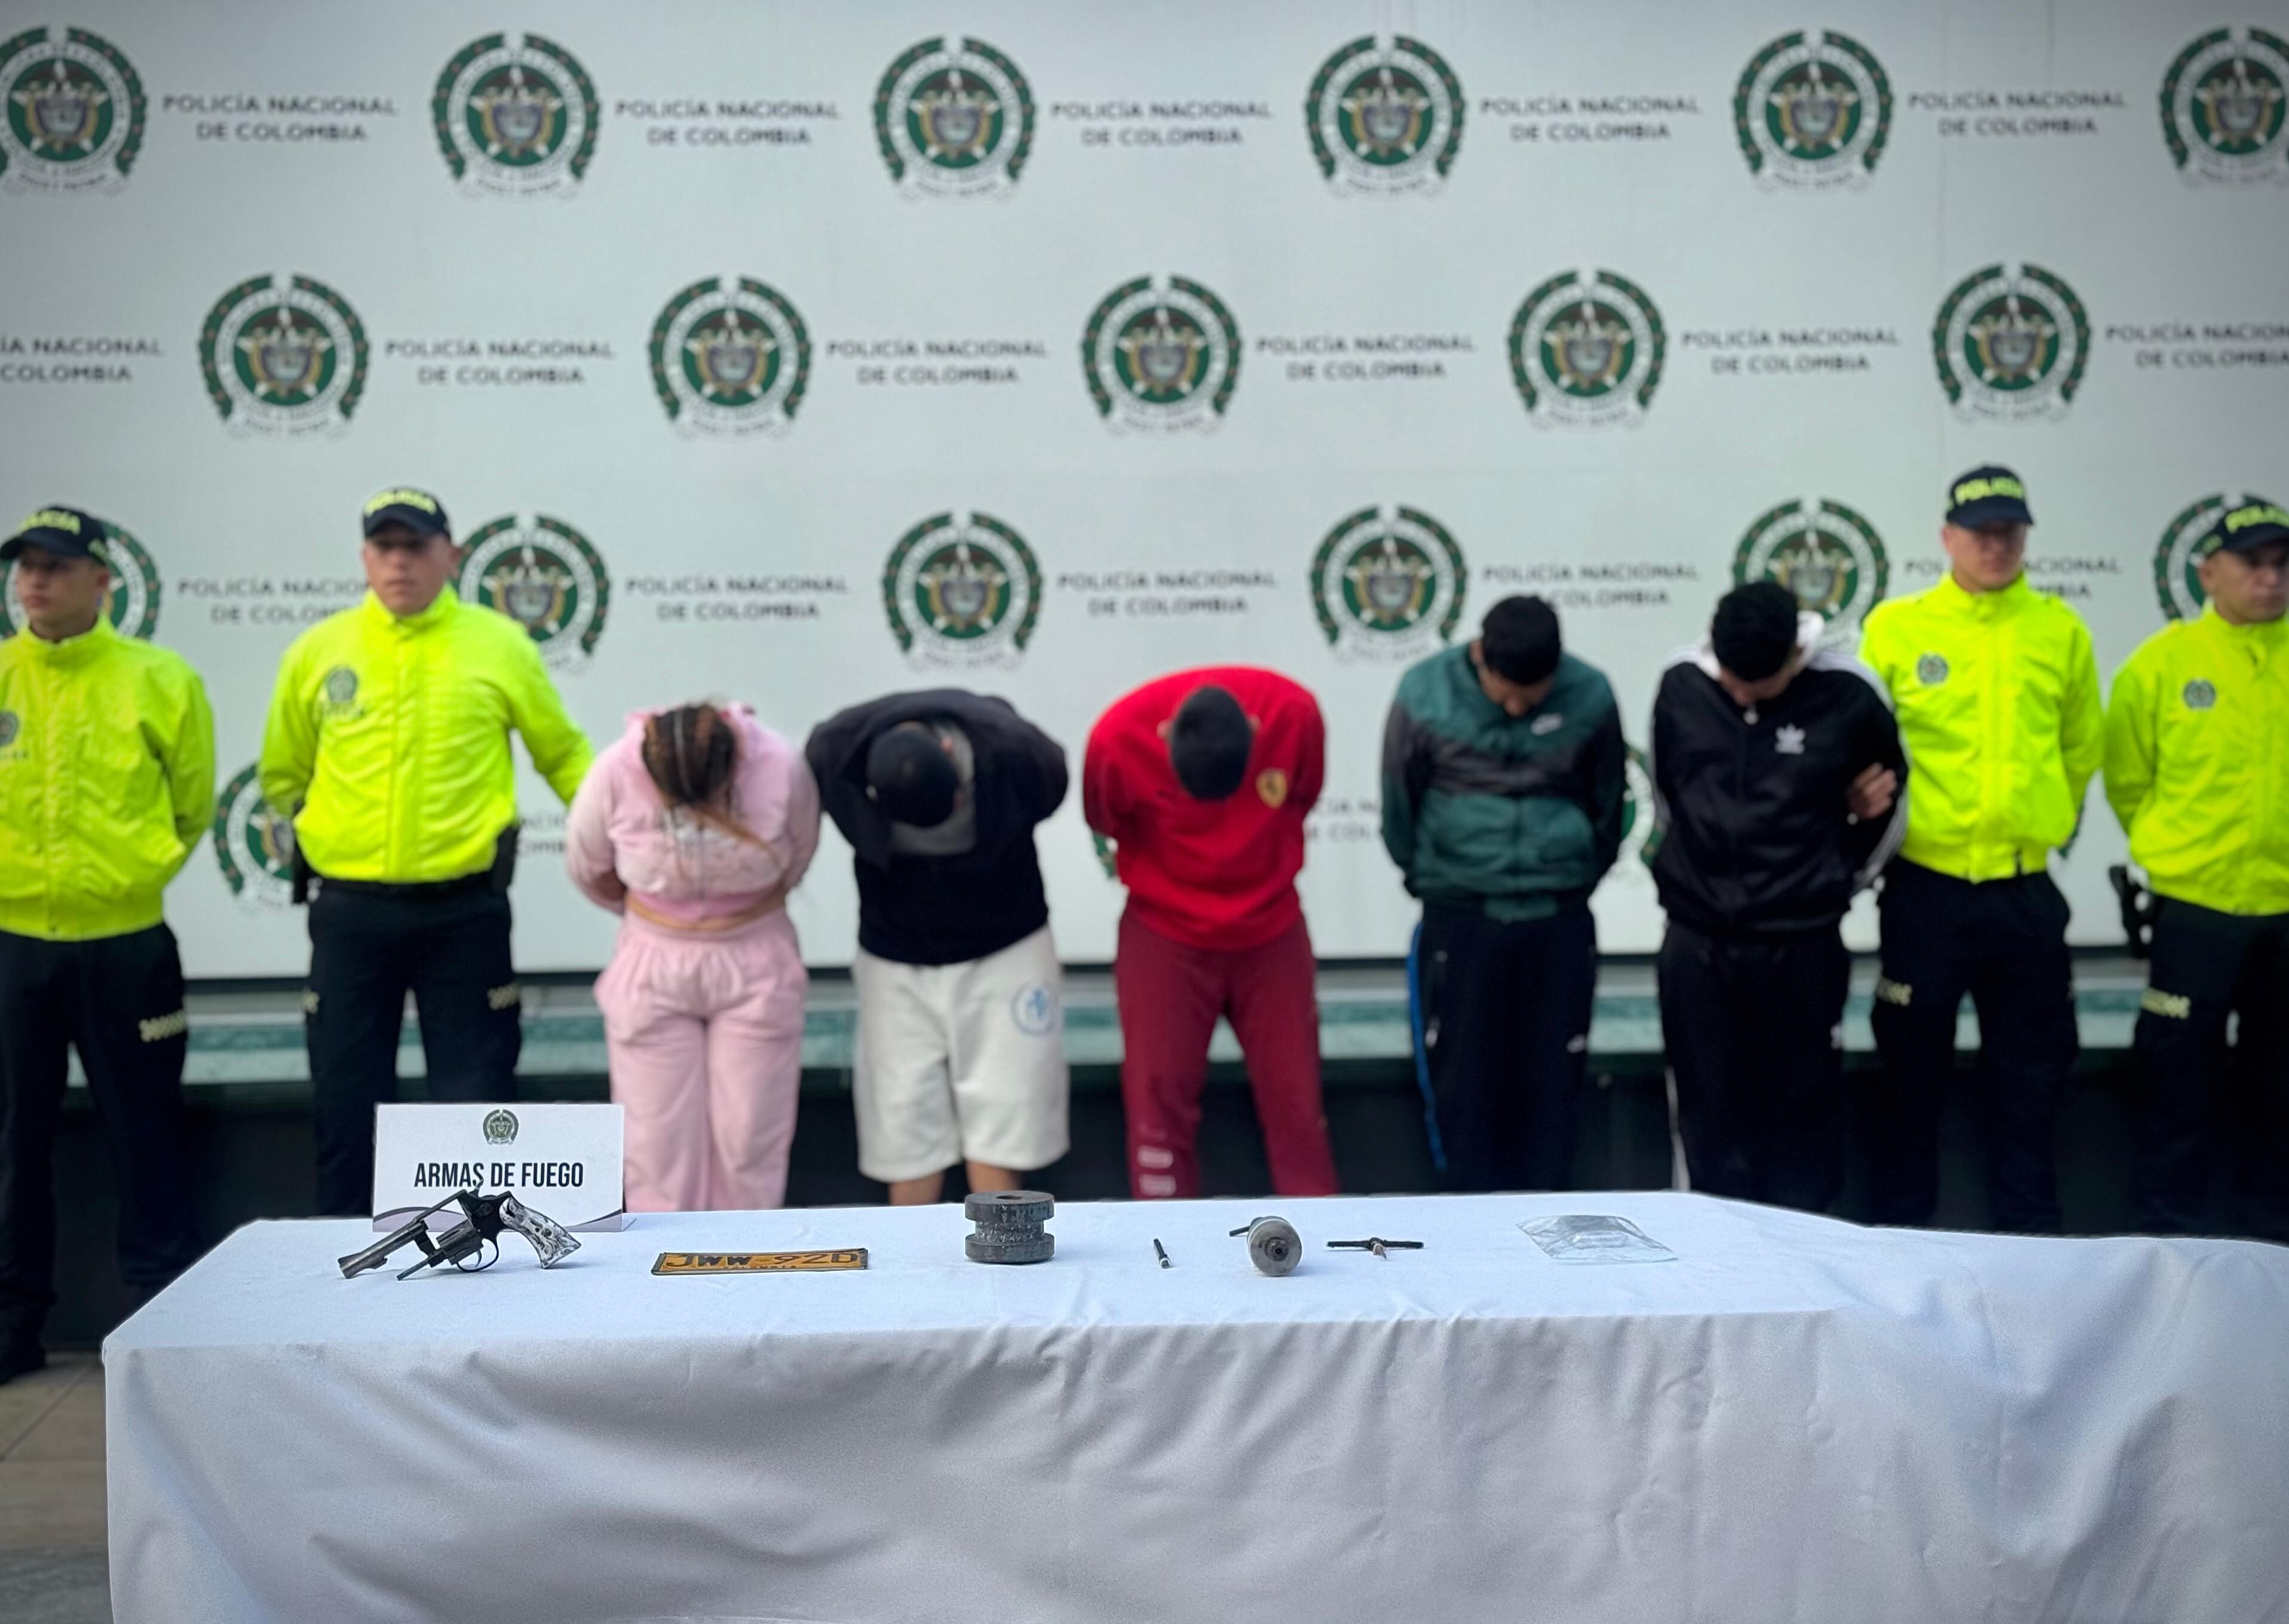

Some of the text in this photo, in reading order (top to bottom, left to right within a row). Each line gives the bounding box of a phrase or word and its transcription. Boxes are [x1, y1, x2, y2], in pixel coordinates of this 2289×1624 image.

[265, 94, 395, 117] NACIONAL
[715, 99, 839, 121] NACIONAL
[1147, 100, 1272, 121] NACIONAL
[1577, 94, 1700, 116] NACIONAL
[2005, 89, 2128, 111] NACIONAL
[194, 120, 367, 143] DE COLOMBIA
[645, 125, 813, 147] DE COLOMBIA
[1080, 126, 1245, 147] DE COLOMBIA
[1509, 121, 1672, 144] DE COLOMBIA
[1937, 116, 2100, 138] DE COLOMBIA
[30, 336, 161, 357] NACIONAL
[1352, 334, 1475, 355] NACIONAL
[1777, 327, 1900, 348] NACIONAL
[486, 339, 614, 361] NACIONAL
[923, 339, 1048, 359] NACIONAL
[2134, 349, 2165, 370] DE
[0, 362, 133, 385] COLOMBIA
[416, 365, 586, 386] DE COLOMBIA
[855, 365, 1020, 386] DE COLOMBIA
[1284, 359, 1447, 382] DE COLOMBIA
[1709, 353, 1872, 376] DE COLOMBIA
[1153, 570, 1276, 590] NACIONAL
[1577, 562, 1699, 583] NACIONAL
[724, 576, 848, 595] NACIONAL
[208, 604, 243, 625] DE
[655, 601, 822, 623] DE COLOMBIA
[1087, 595, 1250, 617] DE COLOMBIA
[414, 1162, 584, 1188] ARMAS DE FUEGO
[774, 1253, 859, 1265] 92D
